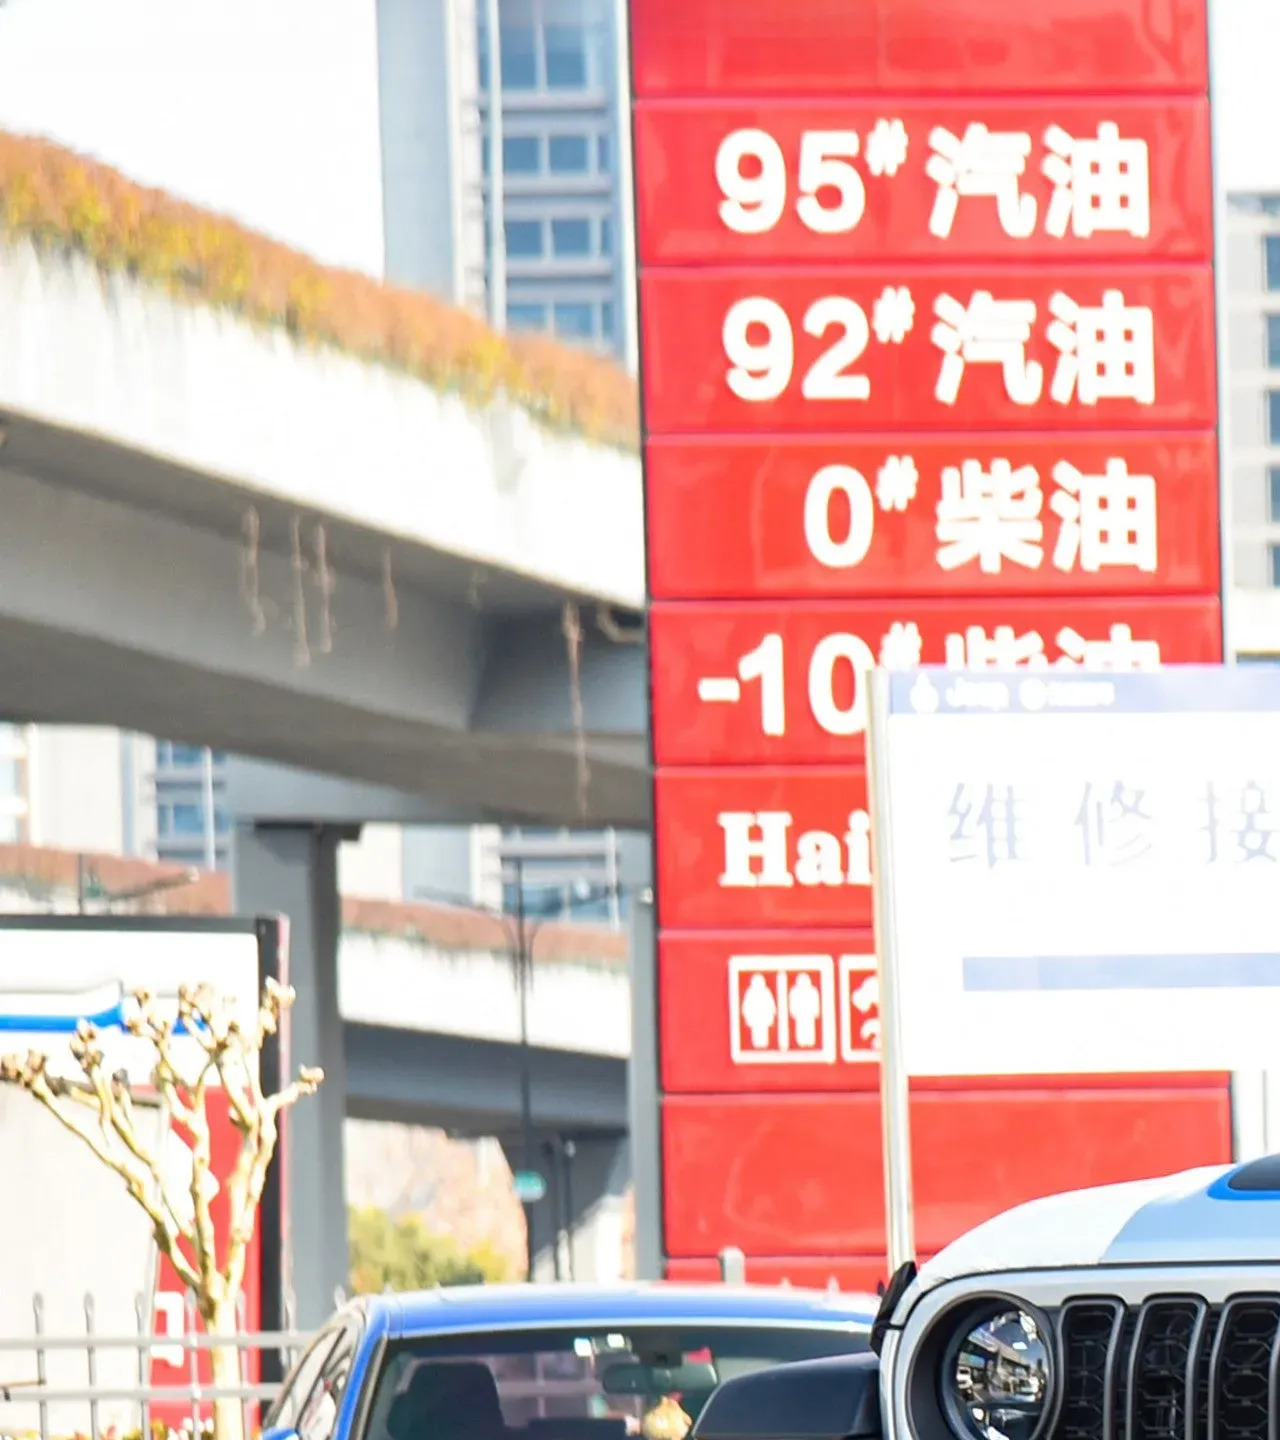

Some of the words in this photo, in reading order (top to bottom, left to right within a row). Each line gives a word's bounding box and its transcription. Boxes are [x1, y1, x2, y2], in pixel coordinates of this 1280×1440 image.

[925, 122, 1151, 238] 汽油
[931, 290, 1156, 405] 汽油
[935, 457, 1158, 574] 柴油
